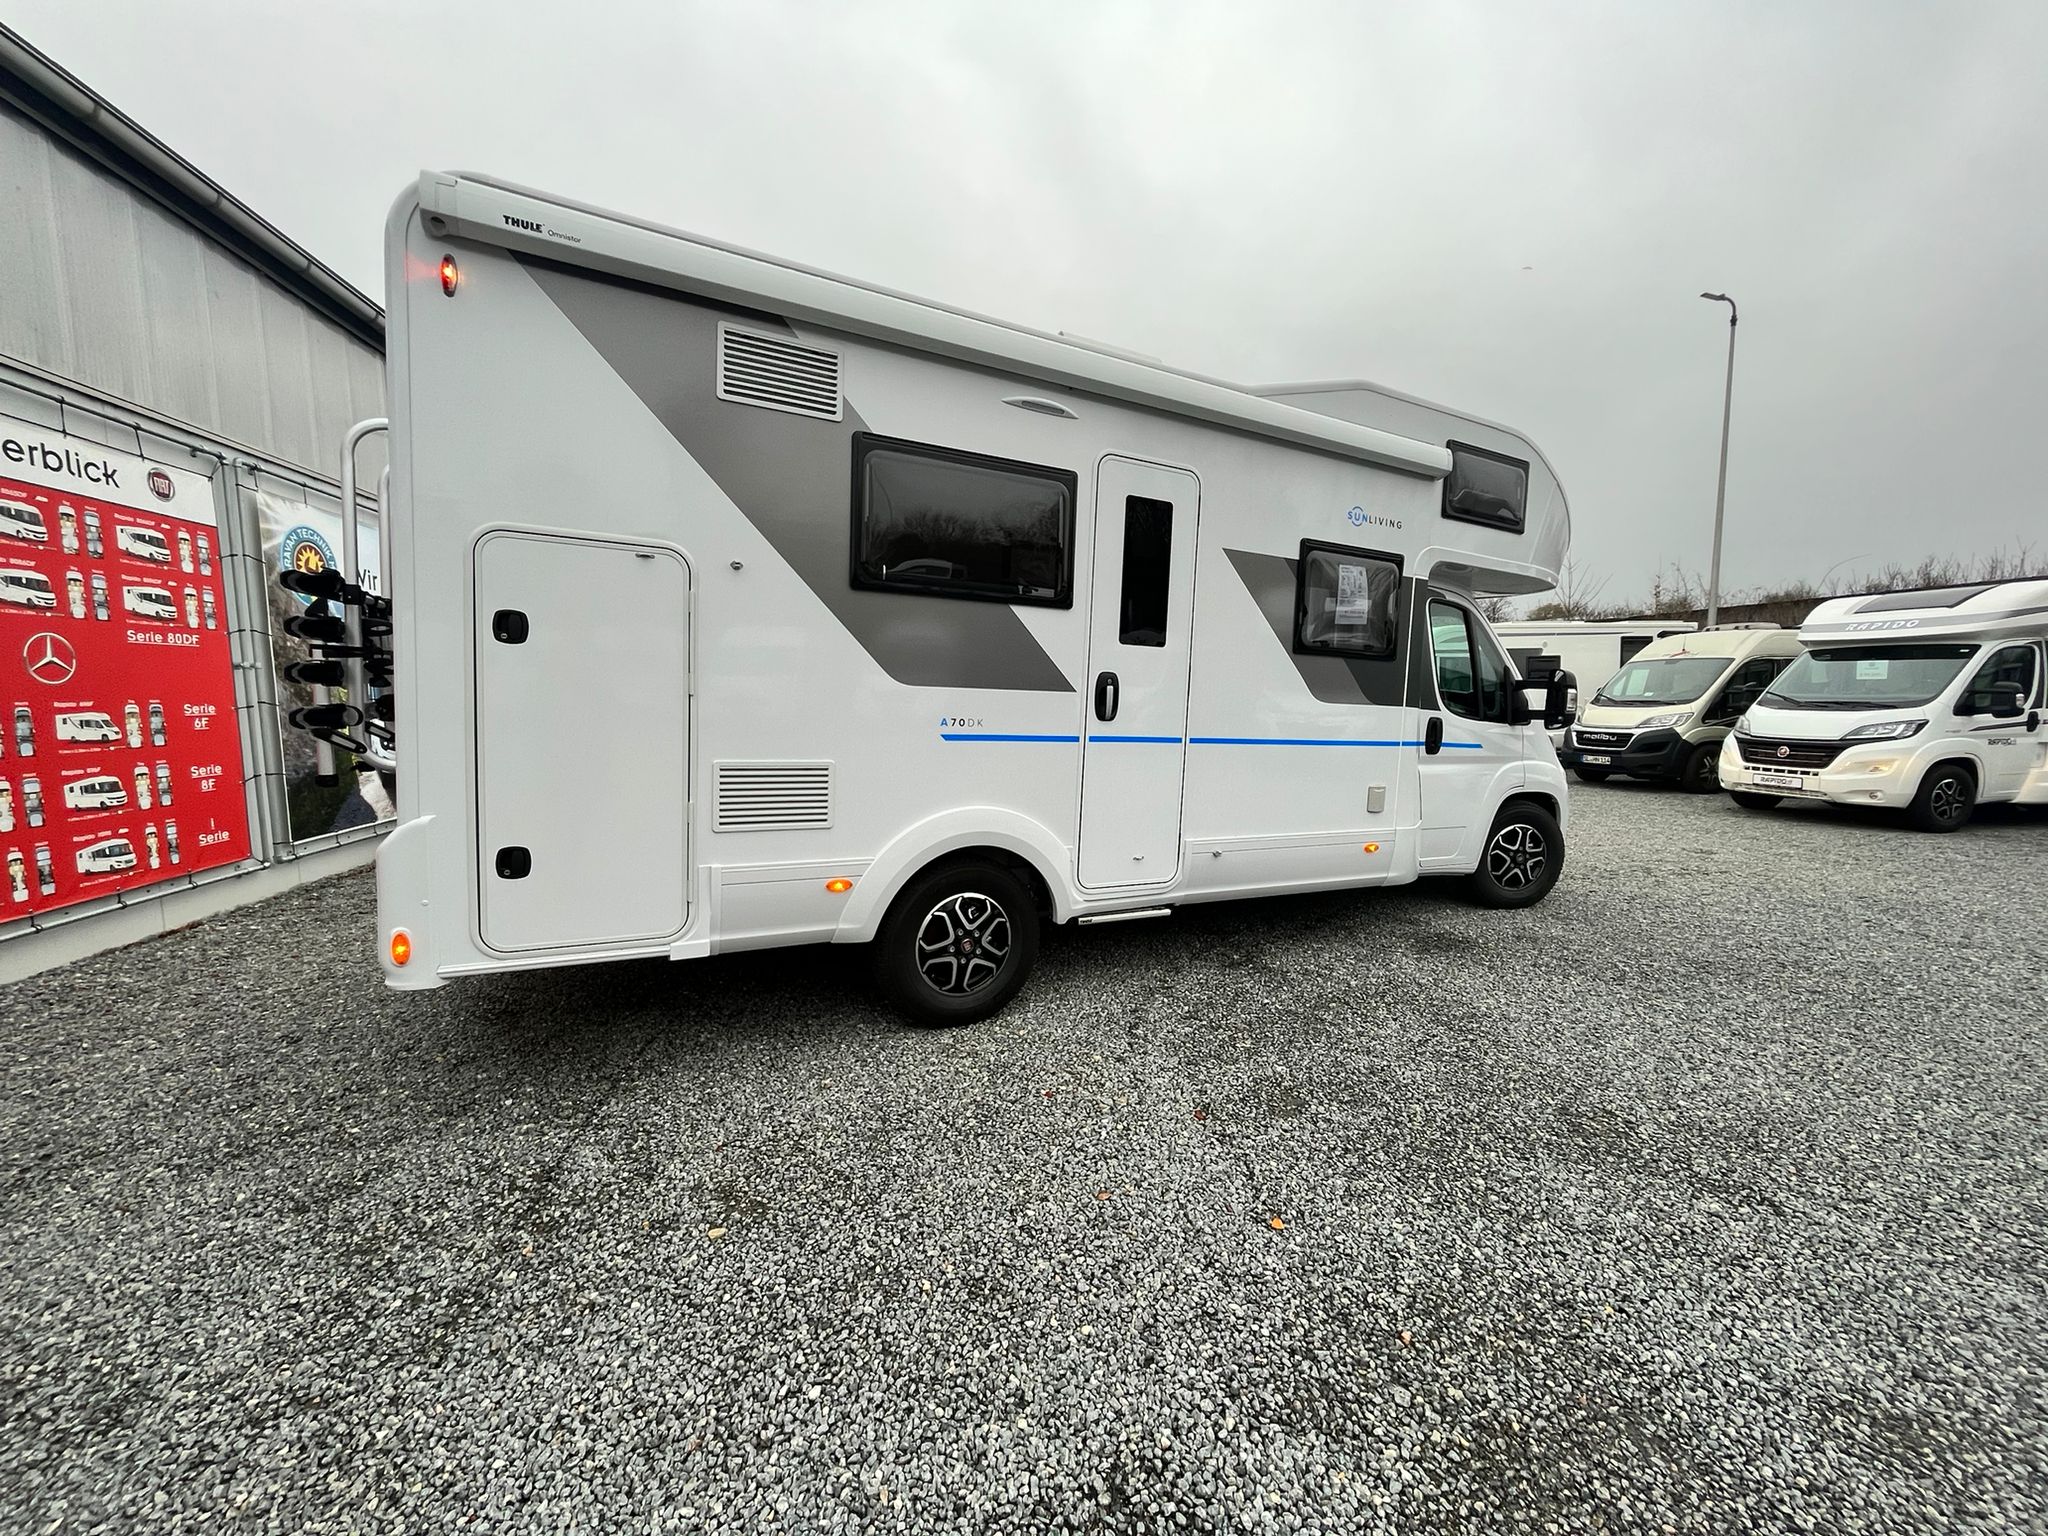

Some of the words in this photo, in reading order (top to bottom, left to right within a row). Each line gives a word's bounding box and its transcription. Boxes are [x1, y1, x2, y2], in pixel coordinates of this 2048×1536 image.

[502, 214, 543, 234] THULE
[547, 229, 582, 244] Omnistor
[153, 475, 170, 495] FIAT
[1347, 508, 1403, 530] SUNLIVING
[283, 532, 298, 568] RAVAN
[297, 528, 333, 560] TECHNIK
[1845, 620, 1920, 631] RAPIDO
[126, 630, 163, 643] Serie
[166, 634, 200, 646] 80DF
[183, 704, 217, 715] Serie
[194, 718, 210, 729] 6F
[940, 718, 984, 728] A70DK
[1583, 733, 1617, 741] malibu
[190, 765, 223, 777] Serie
[201, 779, 216, 790] 8F
[198, 831, 230, 845] Serie
